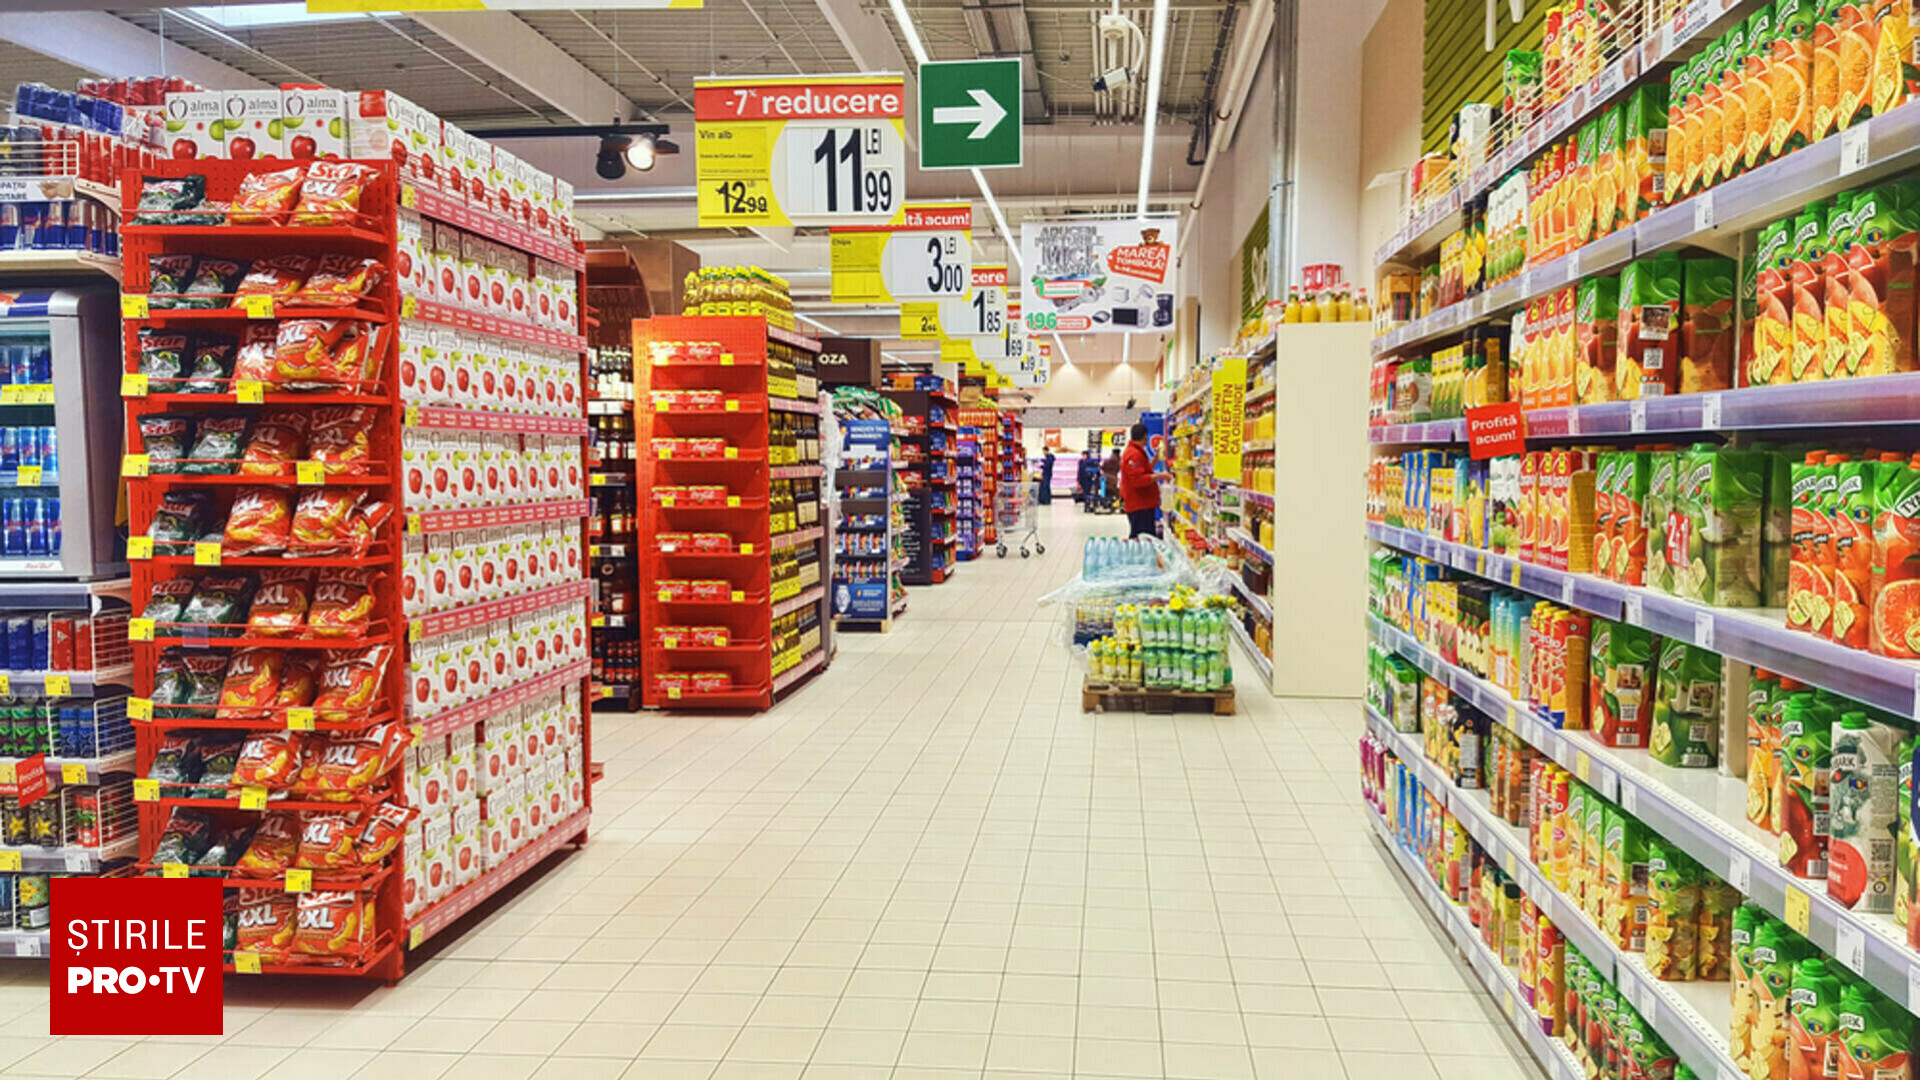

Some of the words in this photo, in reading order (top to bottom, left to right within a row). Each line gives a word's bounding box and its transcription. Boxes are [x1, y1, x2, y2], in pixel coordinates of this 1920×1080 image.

[190, 100, 219, 112] alma
[248, 98, 278, 110] alma
[307, 97, 337, 108] alma
[762, 88, 899, 114] reducere
[699, 130, 715, 139] Vin
[718, 130, 732, 139] alb
[815, 129, 864, 212] 11
[865, 170, 892, 212] 99
[925, 212, 970, 226] acum!
[1116, 247, 1166, 260] MAREA
[927, 237, 943, 292] 3
[944, 265, 963, 292] 00
[973, 291, 985, 332] 1
[987, 312, 1001, 332] 85
[1026, 312, 1057, 329] 196
[819, 353, 848, 365] OZA
[1471, 415, 1518, 431] Profită
[1219, 430, 1230, 455] MAI
[1476, 429, 1516, 445] acum!
